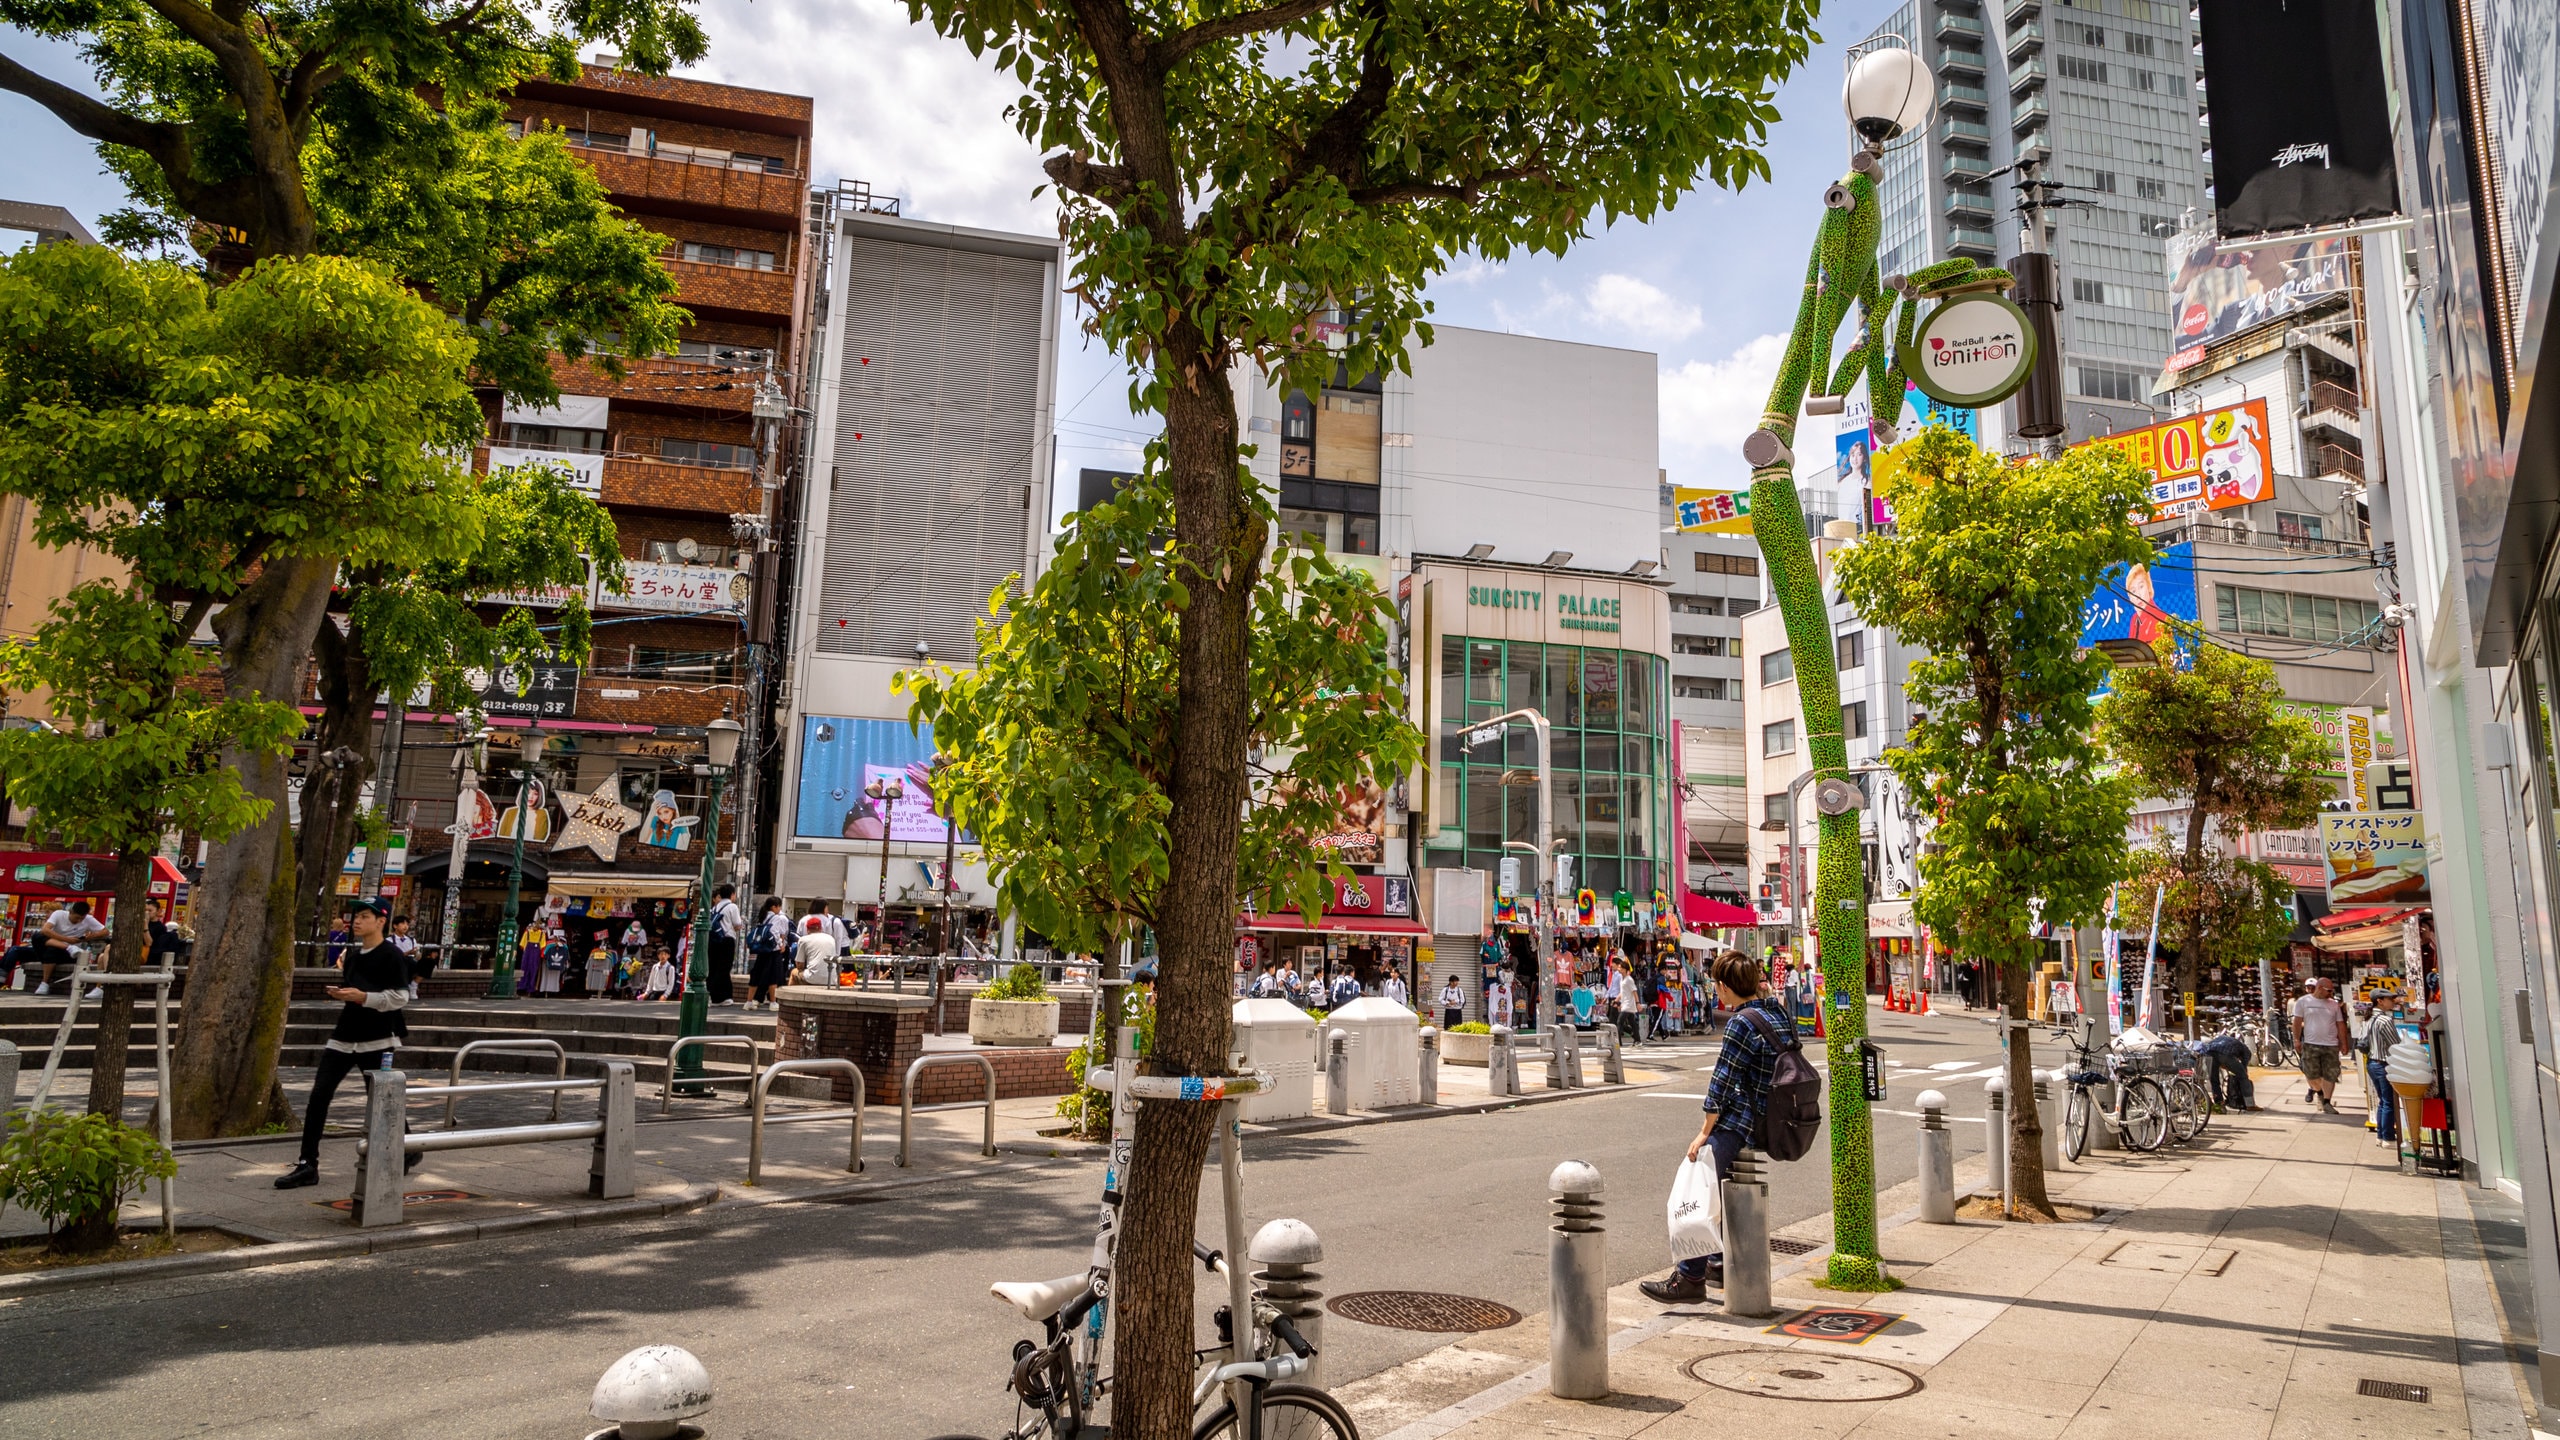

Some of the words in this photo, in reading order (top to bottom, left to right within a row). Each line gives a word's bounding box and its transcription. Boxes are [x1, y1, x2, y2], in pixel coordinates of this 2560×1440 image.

[1952, 338, 1968, 347] Red
[1968, 336, 1984, 346] Bull
[1469, 585, 1541, 611] SUNCITY
[1558, 593, 1620, 618] PALACE
[1560, 618, 1619, 633] SHINSAIBASHI
[545, 702, 566, 713] 3F
[588, 793, 619, 810] hair
[2332, 816, 2413, 829] アイスドッグ
[2369, 830, 2379, 838] &
[2329, 839, 2424, 851] ソフトクリーム
[1866, 1056, 1875, 1079] FREE
[1868, 1080, 1876, 1097] MAP
